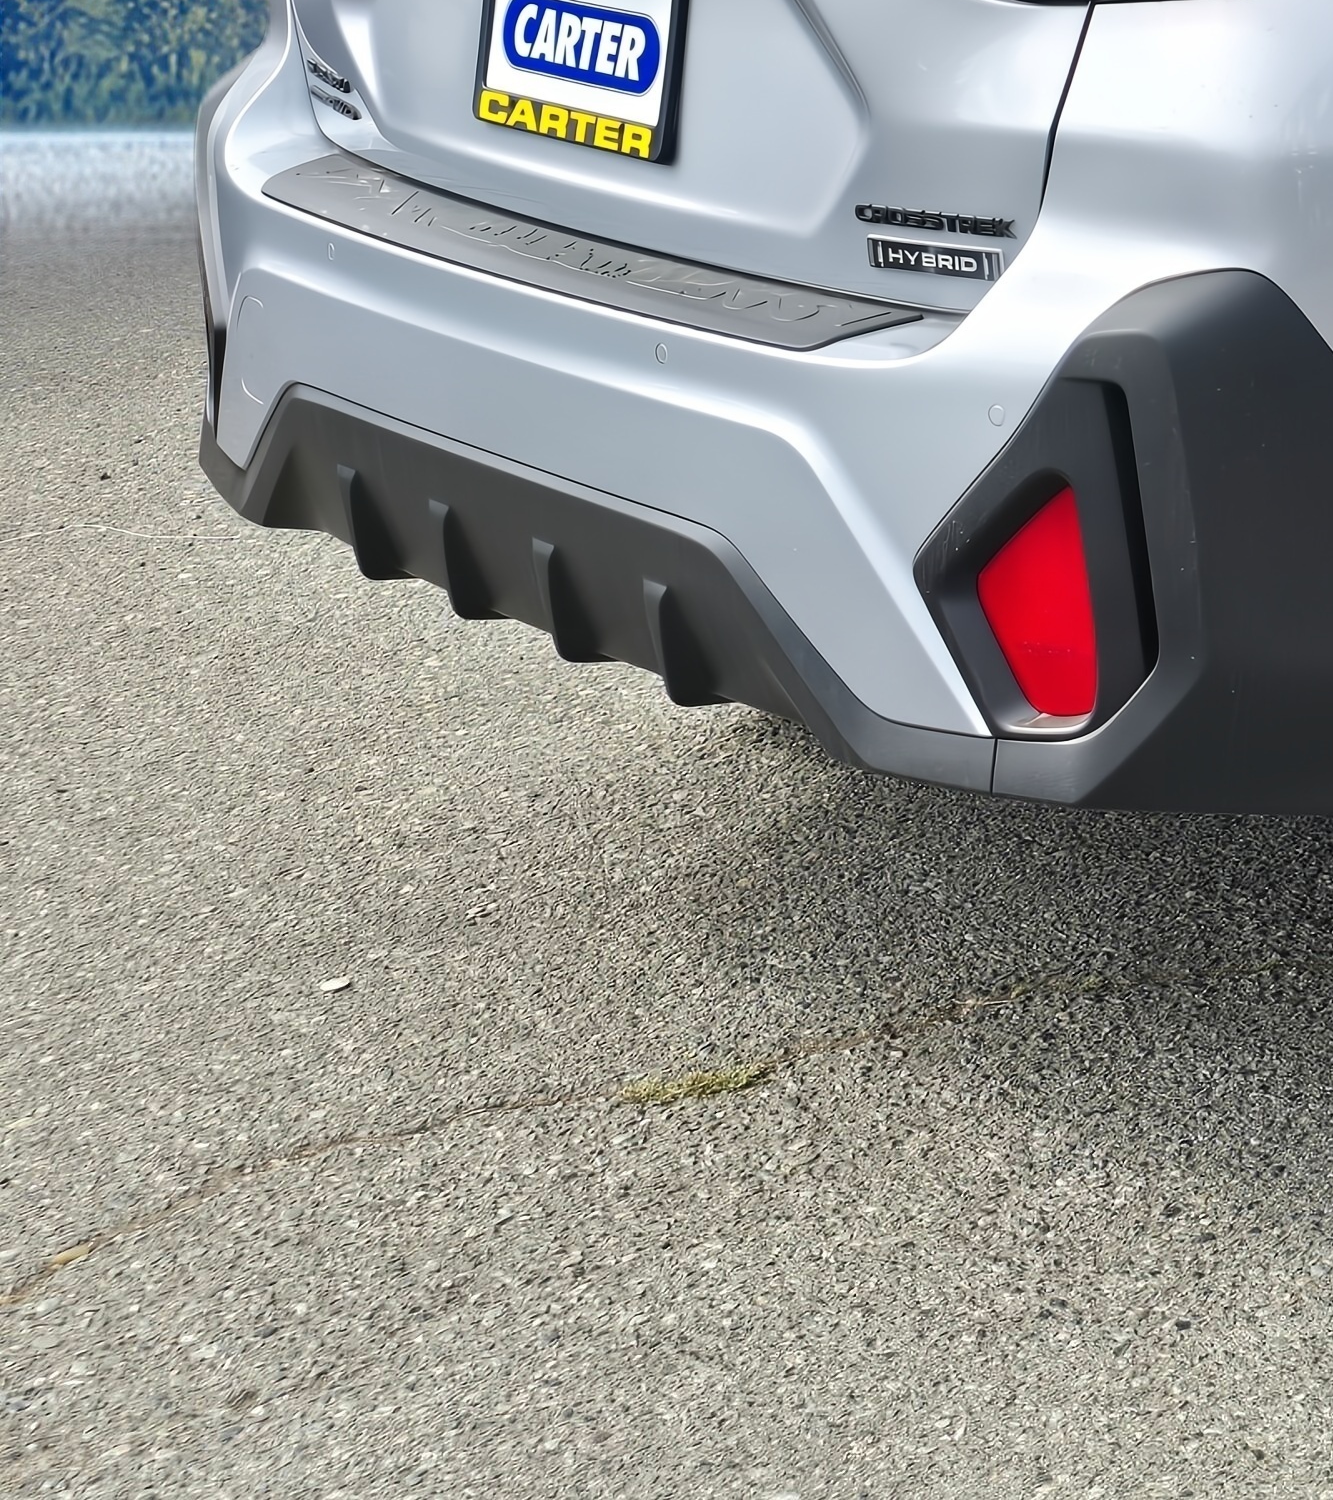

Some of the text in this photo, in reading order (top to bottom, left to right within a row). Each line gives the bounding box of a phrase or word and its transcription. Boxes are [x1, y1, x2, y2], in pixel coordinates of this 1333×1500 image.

[513, 3, 646, 82] CARTER
[479, 90, 653, 159] CARTER
[854, 203, 1018, 240] CROSSTREK
[888, 247, 978, 272] HYBRID
